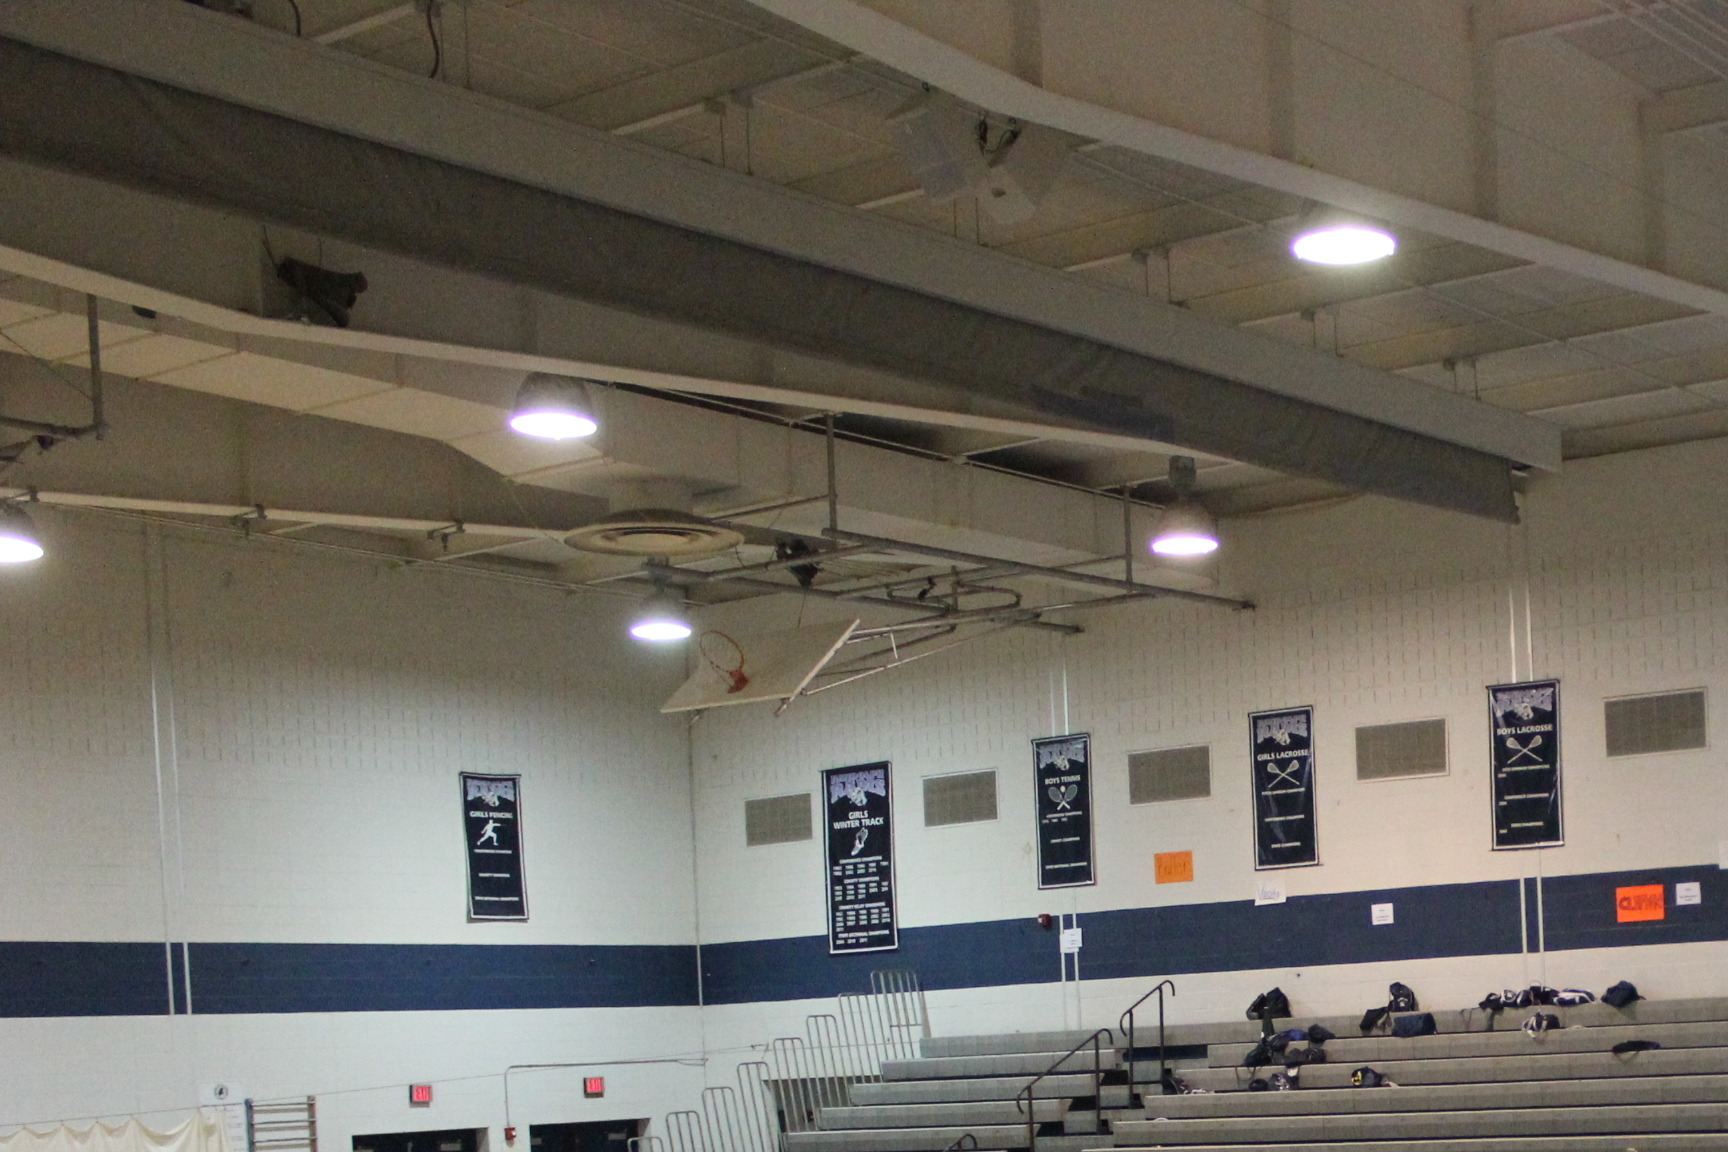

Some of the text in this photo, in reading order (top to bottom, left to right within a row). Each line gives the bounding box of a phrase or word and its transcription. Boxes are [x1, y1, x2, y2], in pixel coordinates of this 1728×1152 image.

[1496, 723, 1553, 736] BOYS LACROSSE
[1257, 749, 1309, 761] GIRLS LACROSSE
[1044, 775, 1081, 785] BOYS TENNIS
[848, 810, 869, 820] GIRLS
[833, 817, 884, 830] WINTER TRACK
